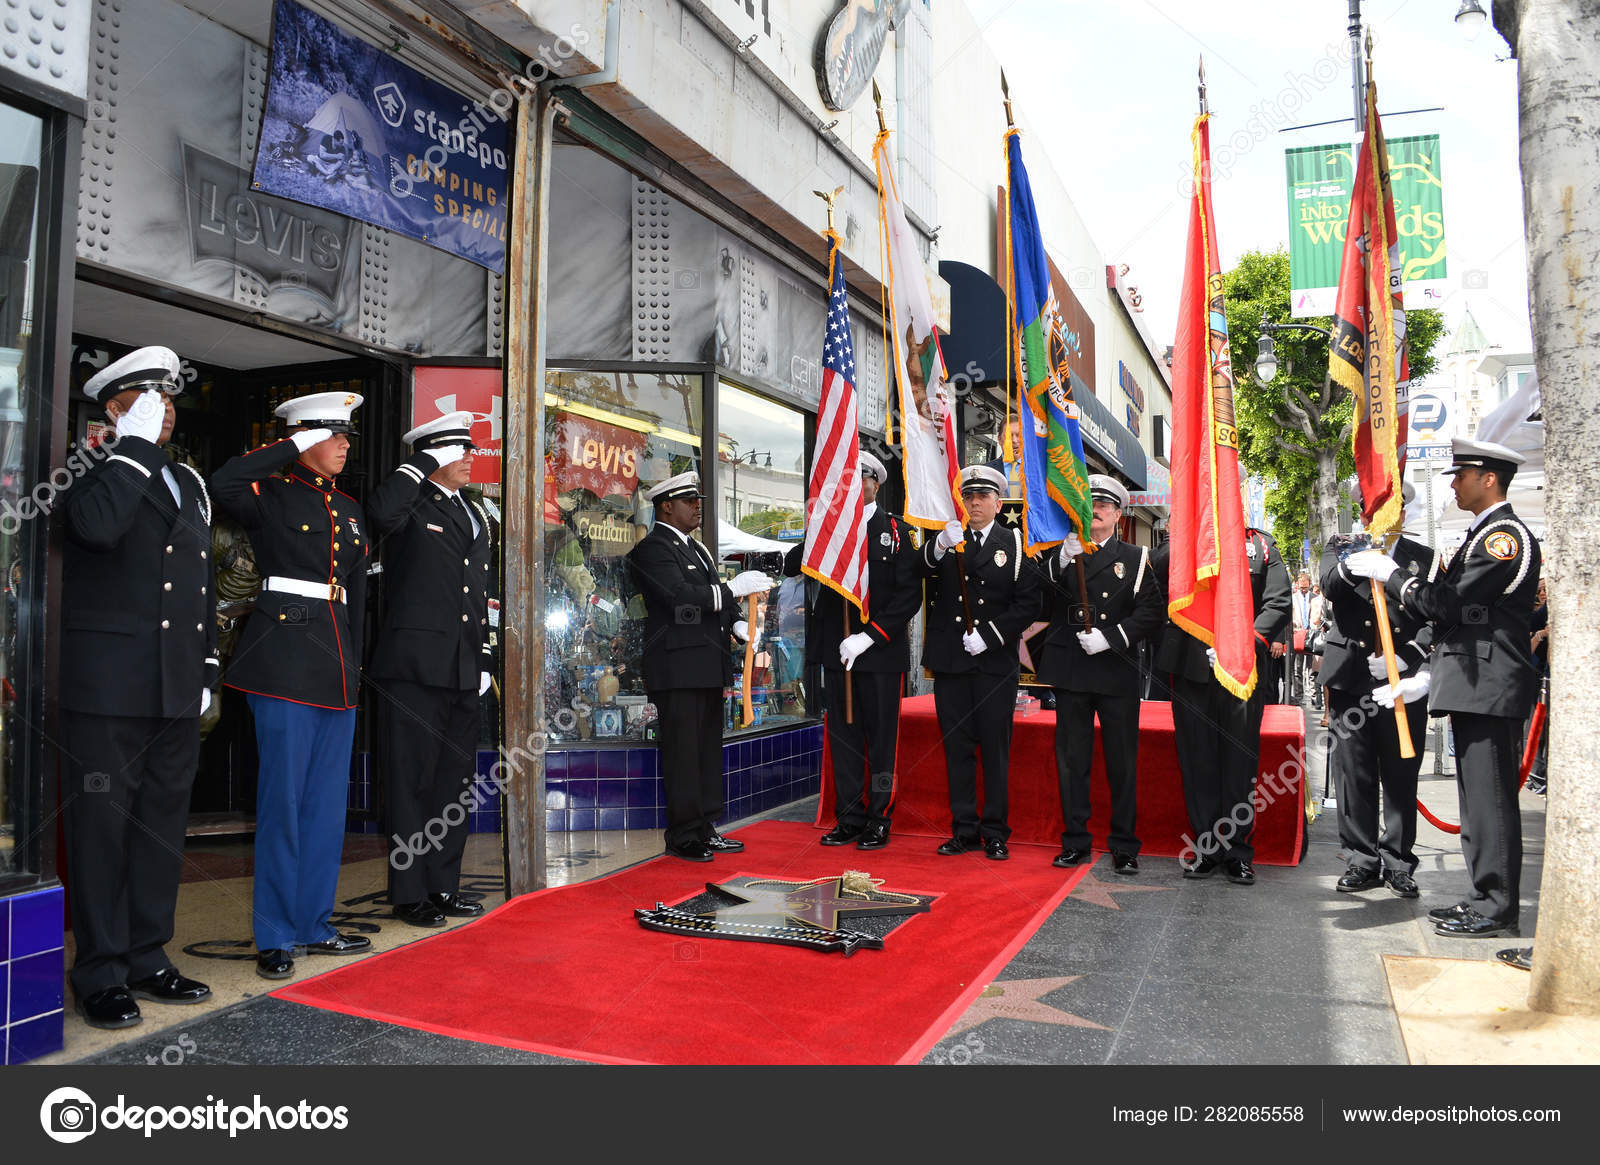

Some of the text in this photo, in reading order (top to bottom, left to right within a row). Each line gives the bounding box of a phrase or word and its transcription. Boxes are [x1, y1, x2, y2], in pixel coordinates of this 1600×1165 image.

[413, 109, 510, 170] stanspo
[406, 153, 497, 207] CAMPING
[1425, 446, 1452, 457] HERE
